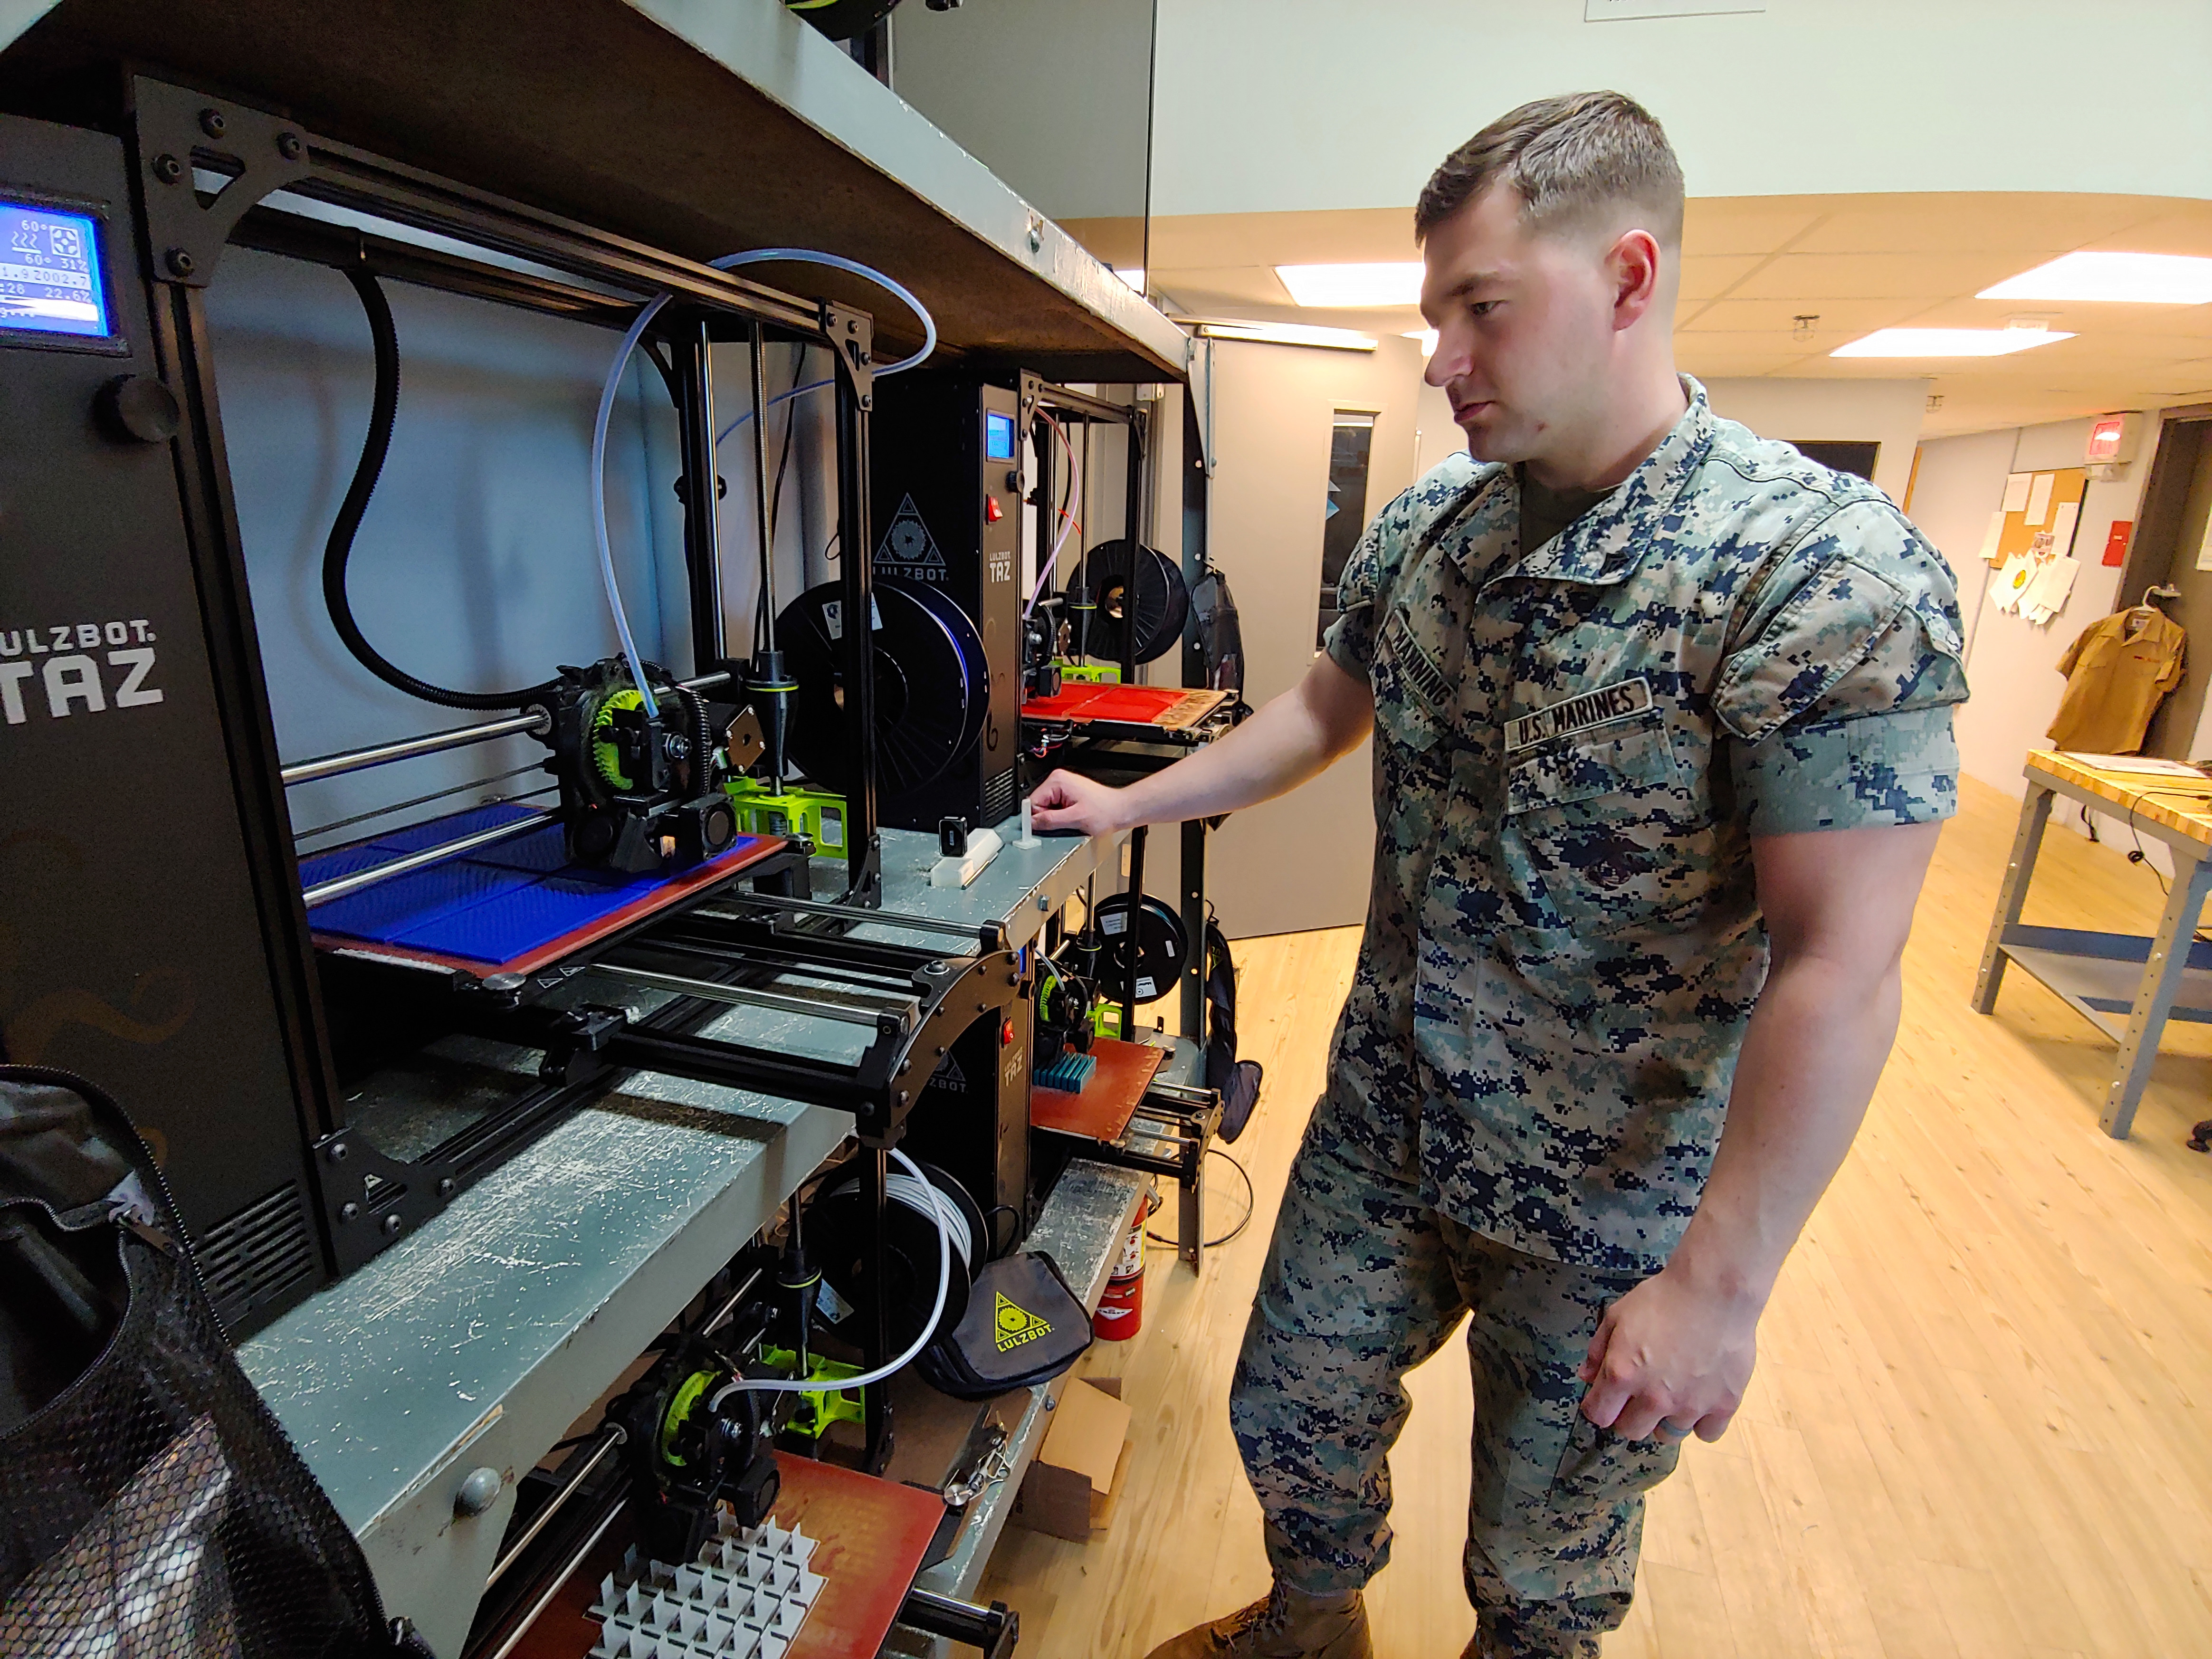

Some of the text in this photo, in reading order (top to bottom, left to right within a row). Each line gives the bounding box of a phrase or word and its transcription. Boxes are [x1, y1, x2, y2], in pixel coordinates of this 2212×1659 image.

[990, 561, 1011, 583] TAZ
[0, 648, 163, 725] TAZ
[1519, 686, 1634, 744] U.S. MARINES
[1004, 1054, 1023, 1087] TAZ
[997, 1324, 1052, 1352] LULZBOT
